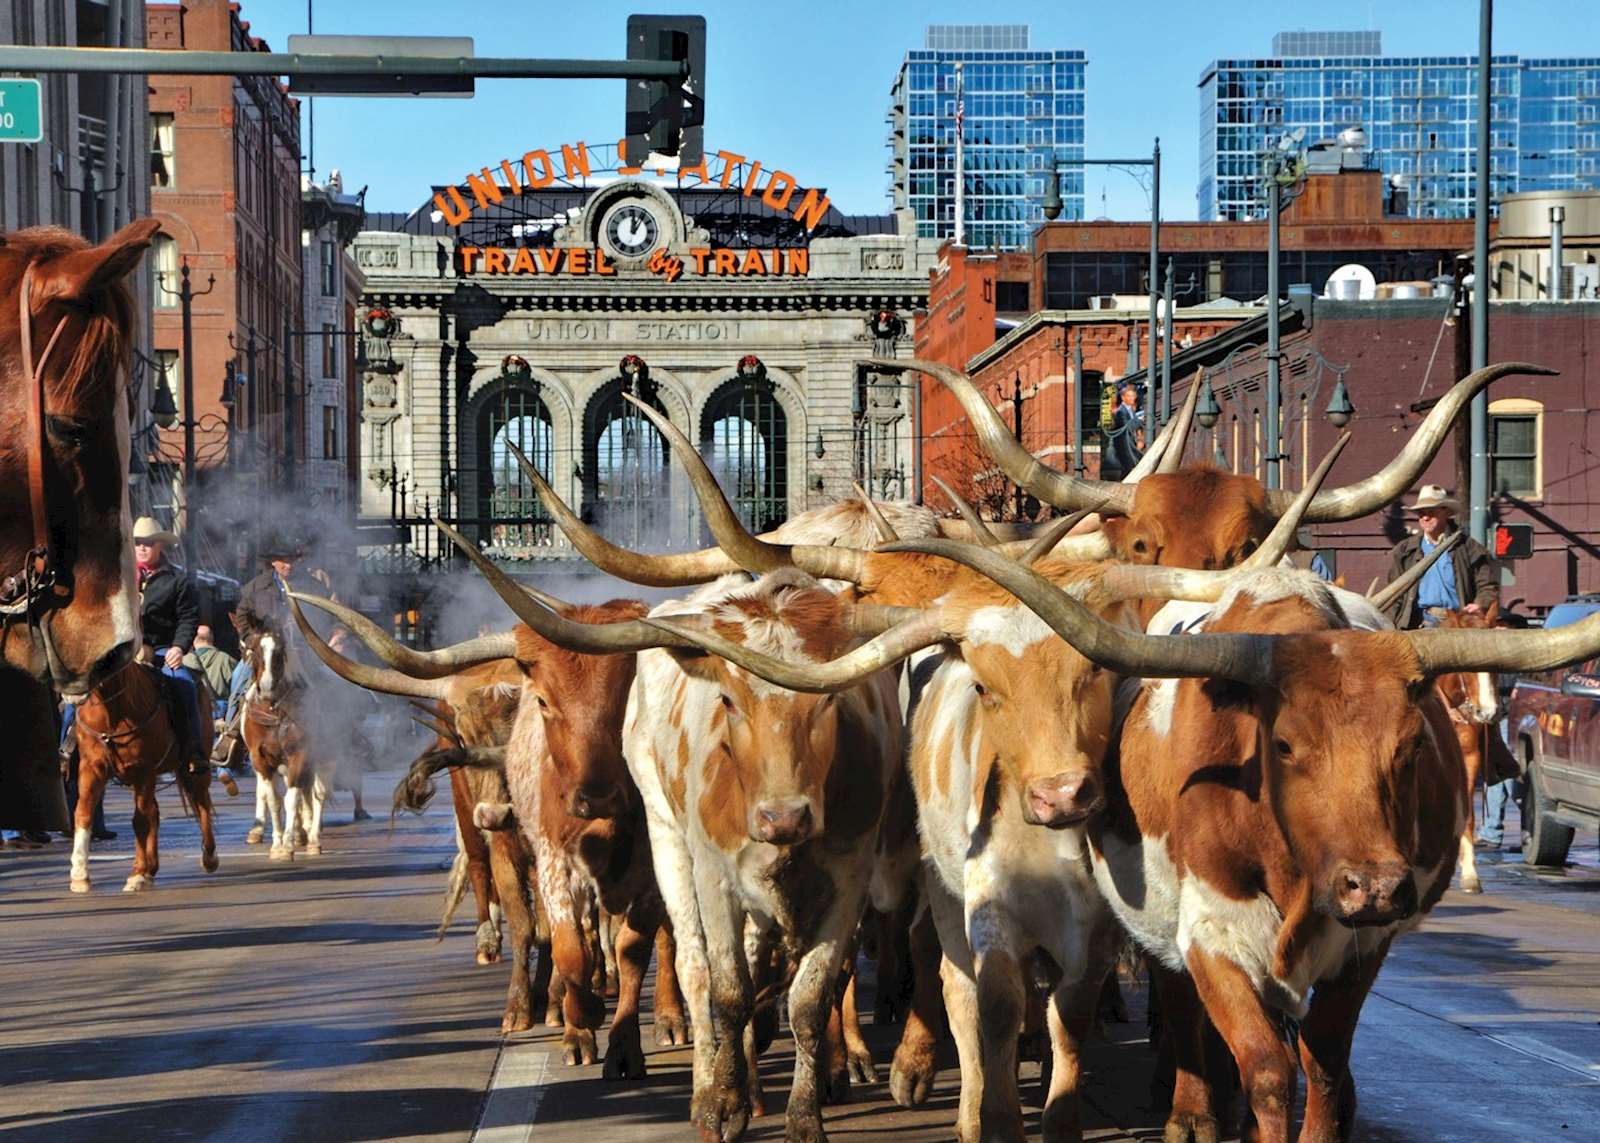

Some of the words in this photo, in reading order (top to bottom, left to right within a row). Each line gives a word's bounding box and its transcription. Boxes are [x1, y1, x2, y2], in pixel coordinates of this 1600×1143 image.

[433, 142, 591, 226] UNION
[461, 247, 614, 274] TRAVEL
[648, 247, 681, 281] by
[690, 247, 809, 274] TRAIN
[526, 322, 610, 340] UNION
[636, 322, 741, 340] STATION
